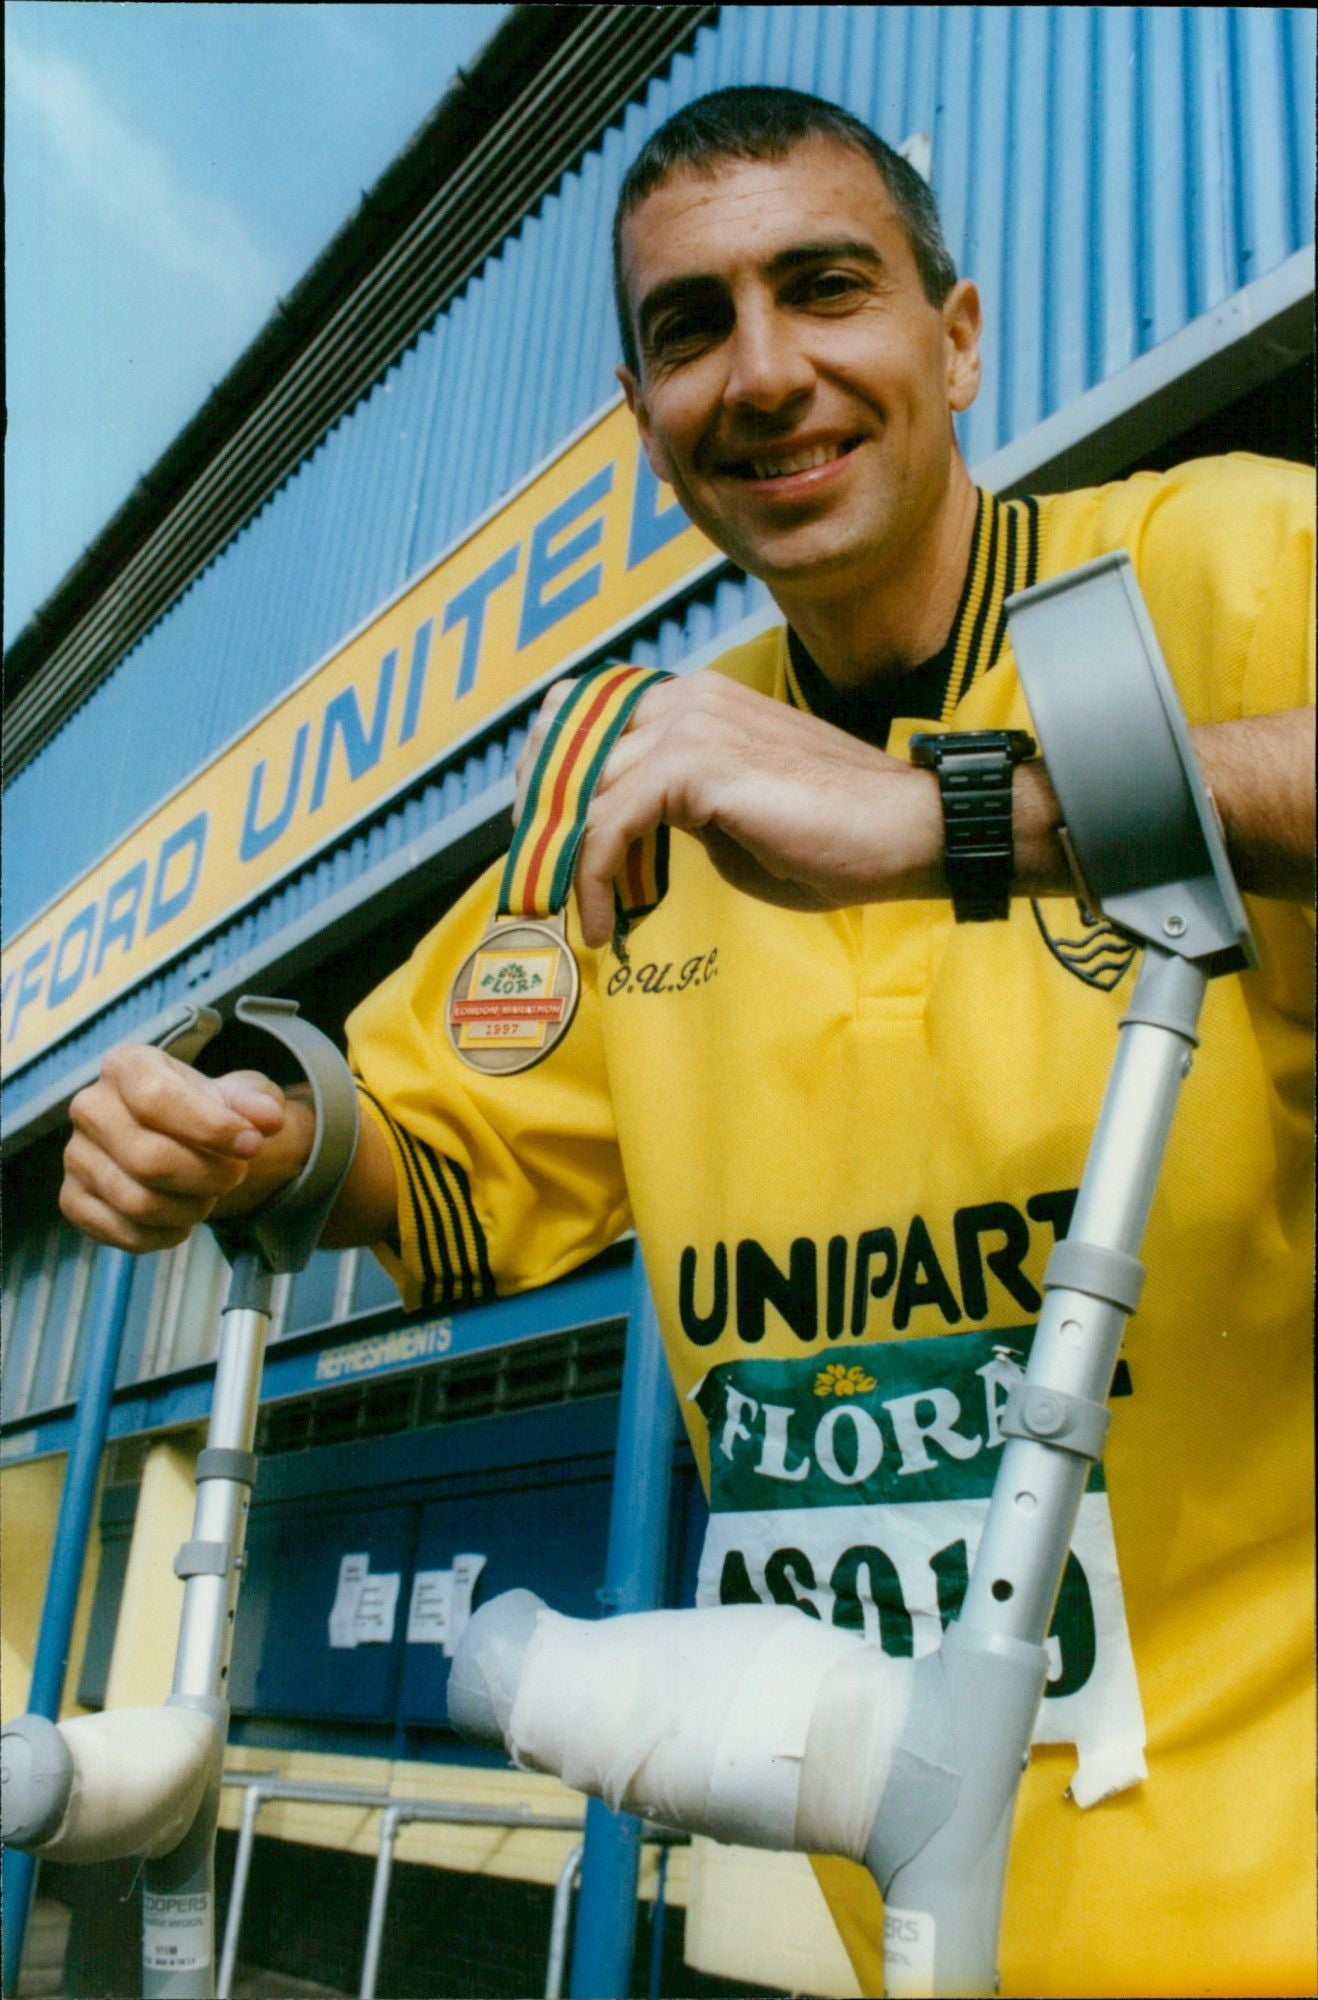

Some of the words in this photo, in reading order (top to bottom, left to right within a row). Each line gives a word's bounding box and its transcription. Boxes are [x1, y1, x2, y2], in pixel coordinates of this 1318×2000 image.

[480, 972, 543, 995] FLORA
[485, 1023, 519, 1036] 1997
[316, 1316, 453, 1380] REFRESHMENTS
[144, 1895, 208, 1913] OOPERS
